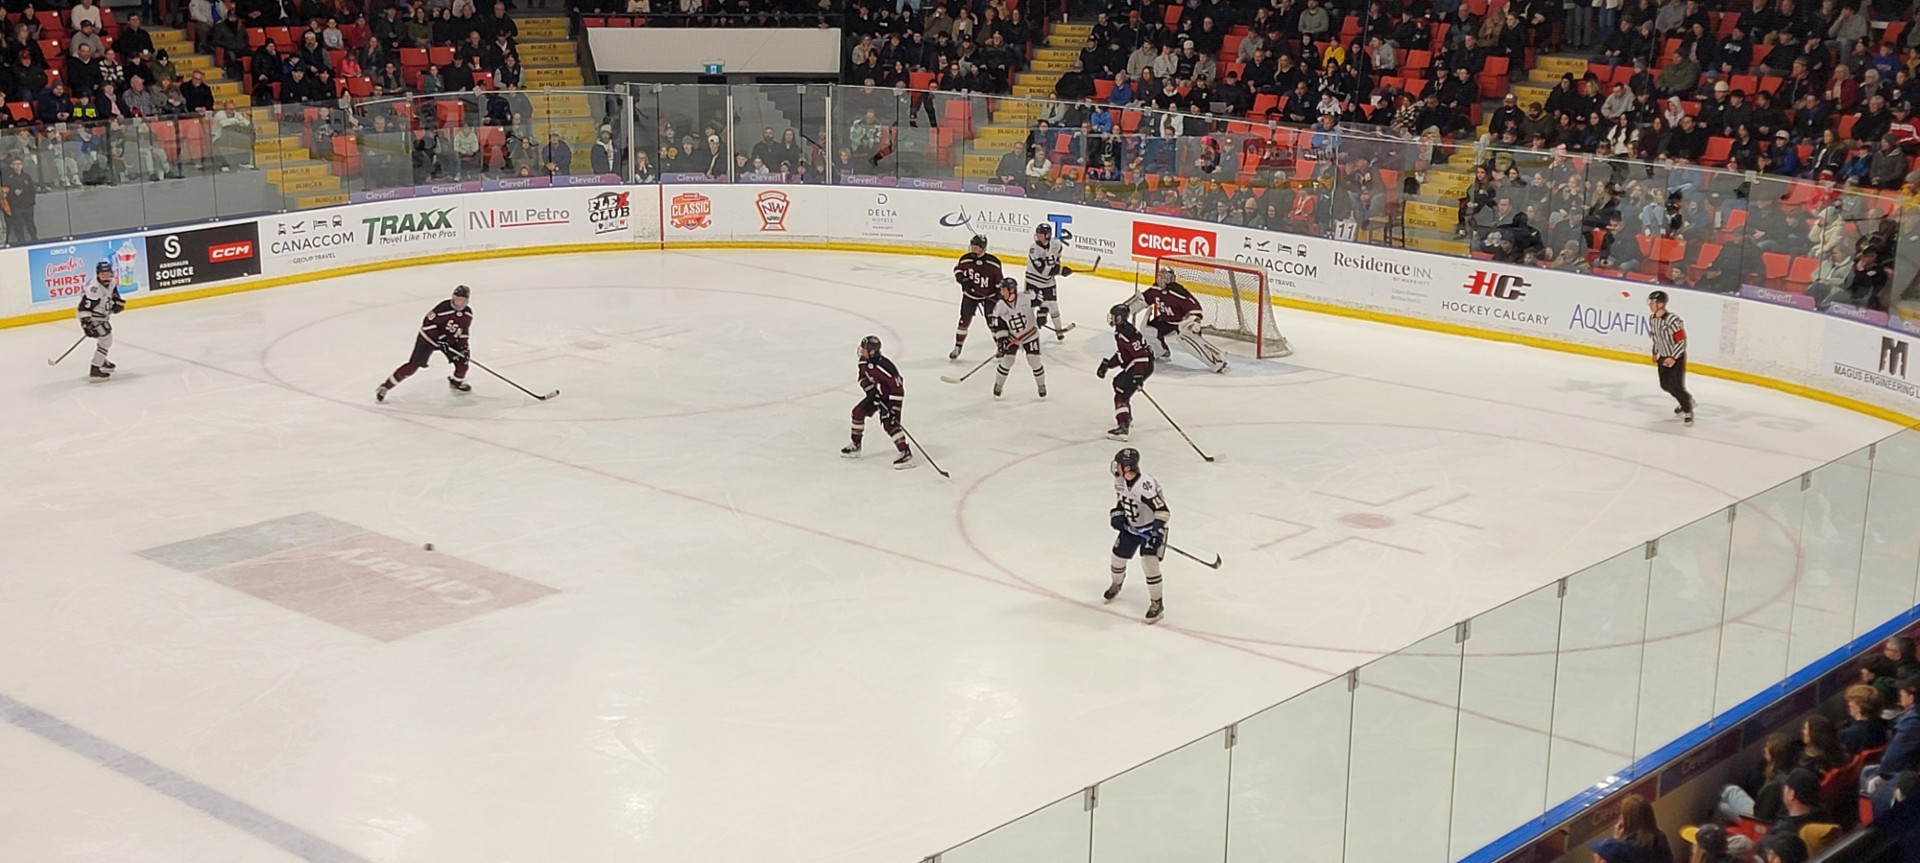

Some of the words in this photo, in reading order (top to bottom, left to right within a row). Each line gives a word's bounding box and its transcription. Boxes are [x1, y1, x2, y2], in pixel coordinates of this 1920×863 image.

[588, 192, 630, 212] FLEX
[672, 201, 710, 217] CLASSIC
[761, 202, 784, 214] NW
[500, 210, 518, 224] MI
[526, 207, 570, 222] Petro
[589, 206, 630, 223] CLUB
[868, 208, 898, 217] DELTA
[977, 210, 1030, 226] ALARIS
[362, 206, 458, 245] TRAXX
[1339, 222, 1355, 240] 11
[270, 232, 354, 255] CANACCOM
[379, 235, 402, 245] Travel
[404, 234, 420, 242] Like
[422, 232, 437, 240] The
[438, 230, 456, 238] Pros
[1074, 235, 1098, 246] TIMES
[1099, 238, 1116, 248] TWO
[1138, 233, 1187, 253] CIRCLE
[212, 245, 250, 258] CCM
[292, 256, 314, 264] GROUP
[314, 252, 336, 260] TRAVEL
[1334, 251, 1411, 276] Residence
[45, 274, 87, 287] THIRST
[156, 266, 194, 280] SOURCE
[968, 268, 990, 288] SSM
[1275, 278, 1296, 288] TRAVEL
[1465, 270, 1530, 300] HC
[1442, 300, 1491, 316] HOCKEY
[1494, 308, 1550, 326] CALGARY
[1834, 365, 1863, 381] MAGUS
[1864, 373, 1915, 397] ENGINEERING
